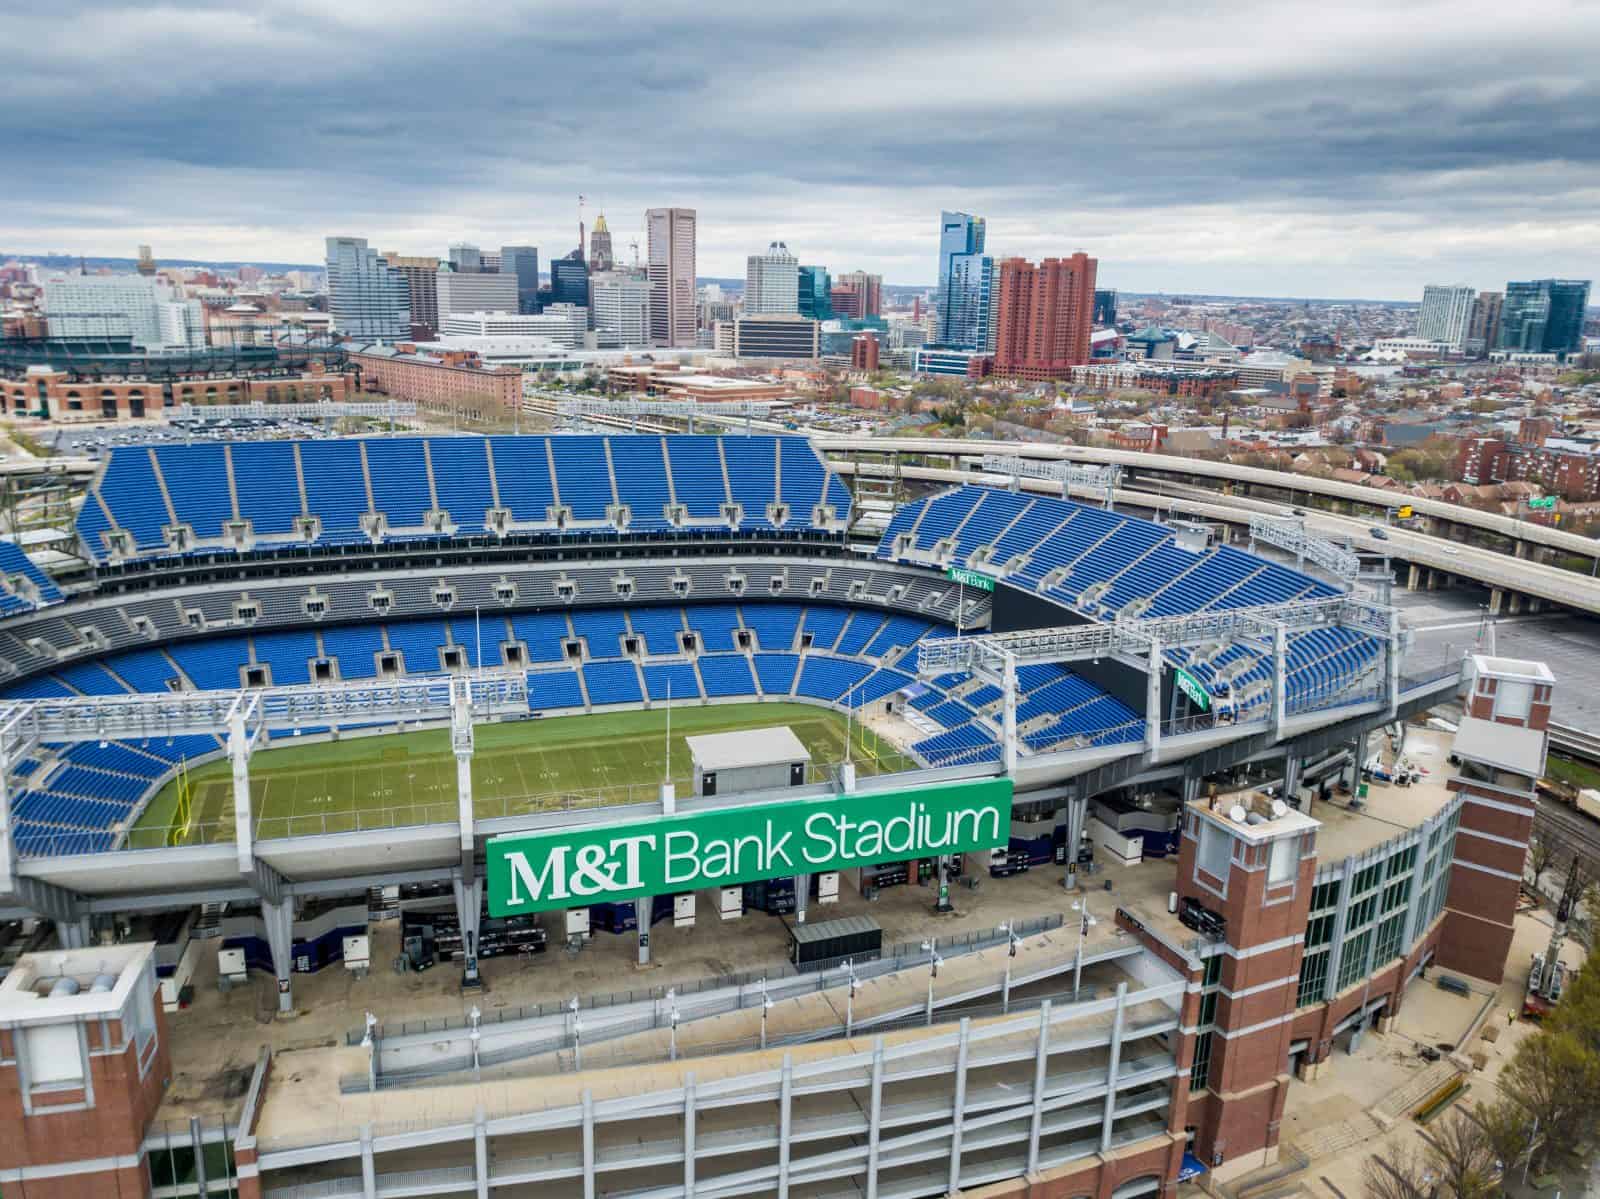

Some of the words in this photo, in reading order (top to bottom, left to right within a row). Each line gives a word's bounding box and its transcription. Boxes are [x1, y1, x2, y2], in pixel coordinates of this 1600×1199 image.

[505, 834, 655, 906] M&T
[664, 820, 794, 884] Bank
[802, 802, 999, 863] Stadium
